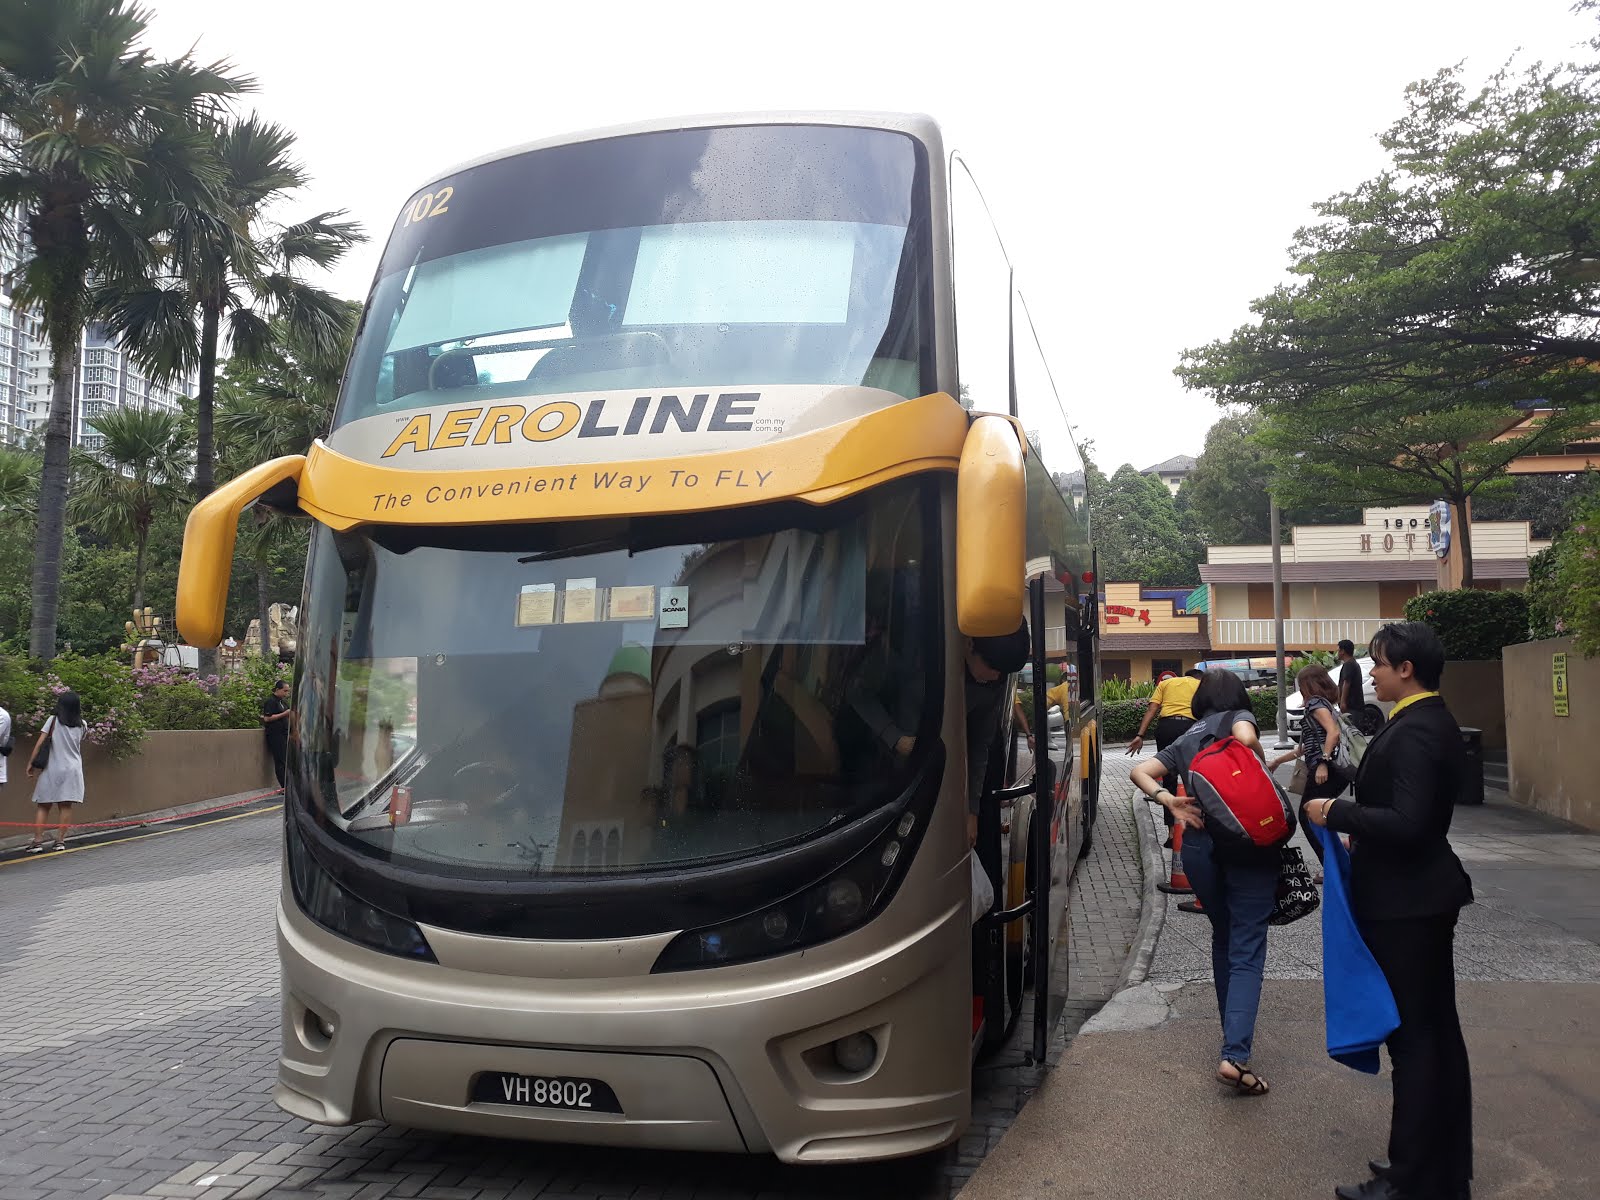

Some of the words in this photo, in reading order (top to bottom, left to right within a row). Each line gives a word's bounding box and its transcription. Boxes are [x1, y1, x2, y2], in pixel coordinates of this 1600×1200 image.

[403, 186, 454, 228] 102
[381, 392, 761, 459] AEROLINE
[373, 494, 412, 512] The
[425, 473, 578, 504] Convenient
[593, 471, 652, 493] Way
[670, 470, 699, 488] To
[716, 469, 774, 488] FLY
[1106, 605, 1135, 617] TERN
